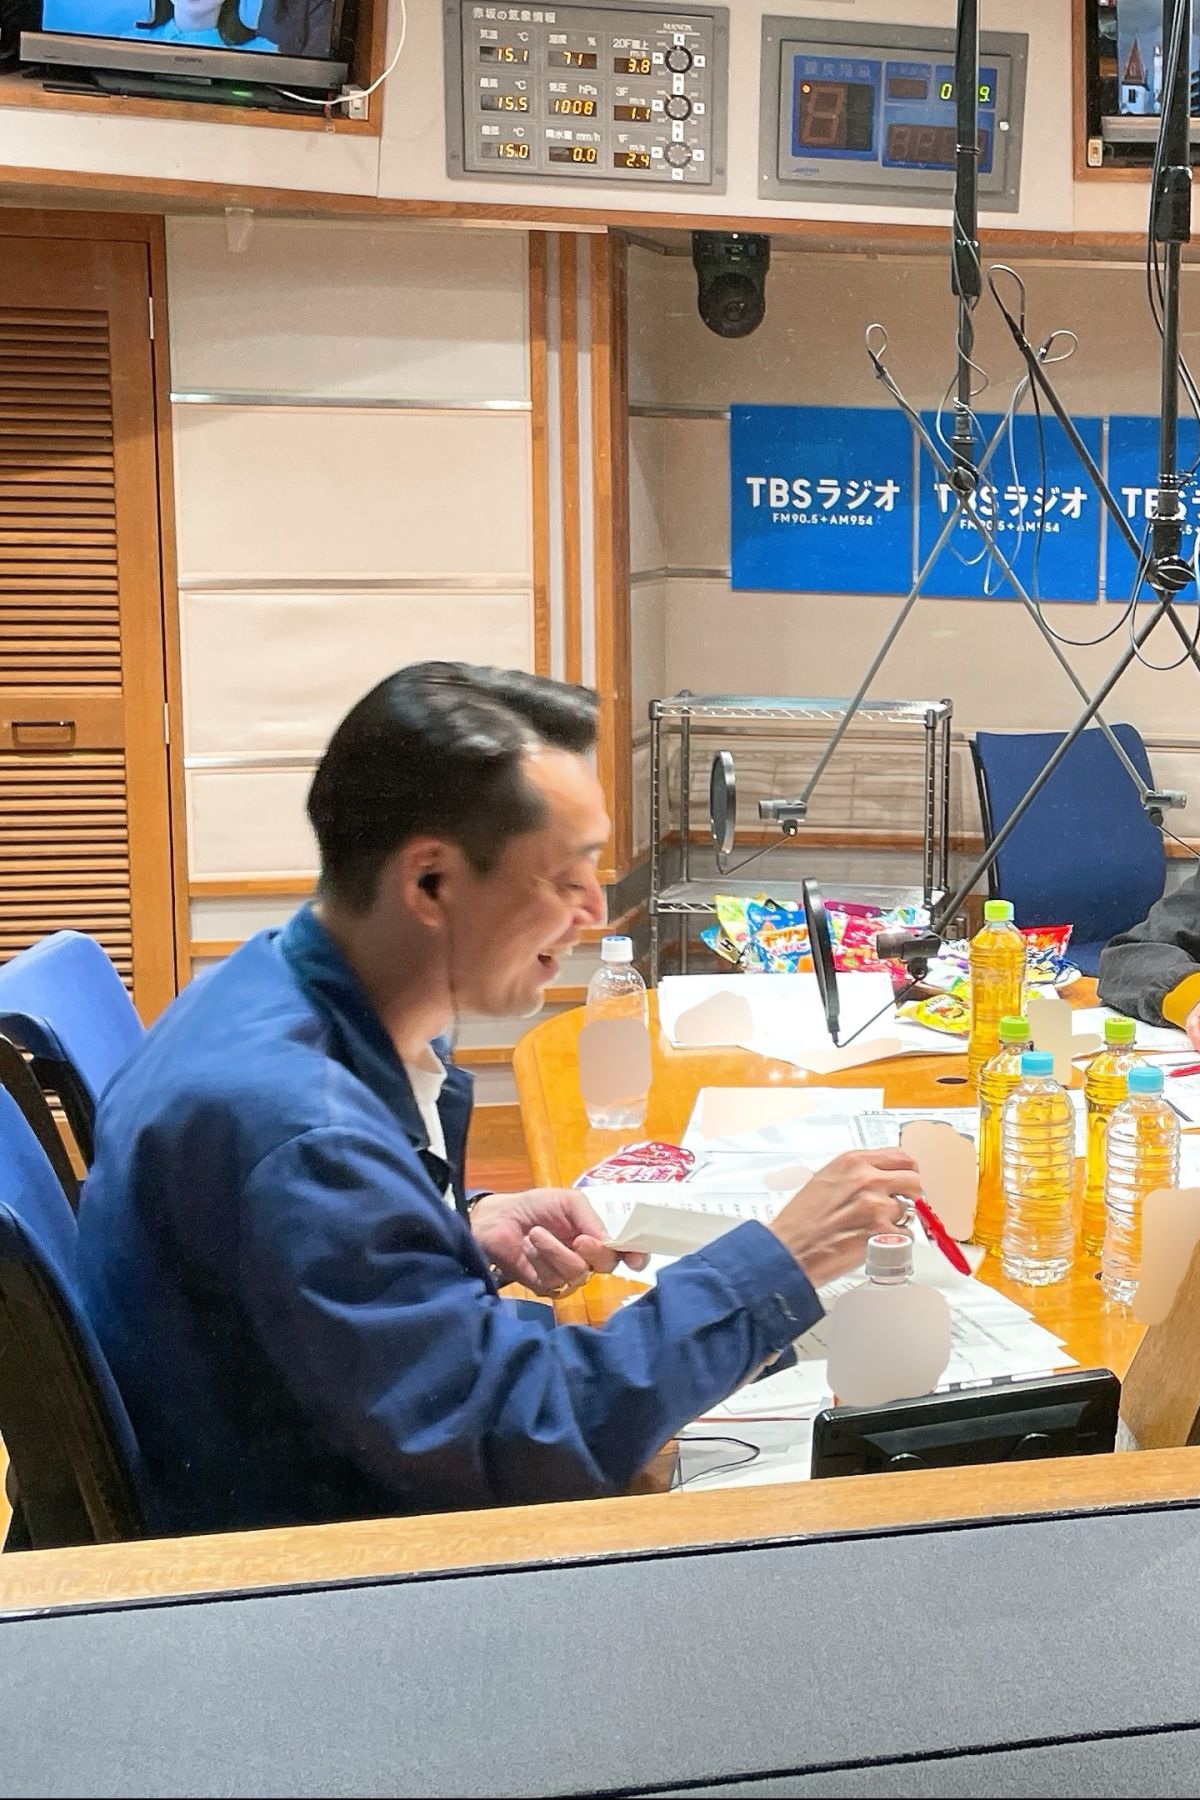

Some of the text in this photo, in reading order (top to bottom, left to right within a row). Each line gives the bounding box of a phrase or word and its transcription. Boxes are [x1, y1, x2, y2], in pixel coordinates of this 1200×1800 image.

[554, 99, 594, 116] 1008
[746, 476, 900, 512] TBSラジオ
[772, 512, 873, 526] FM90.5+AM954
[959, 519, 1061, 533] FM905+AM54
